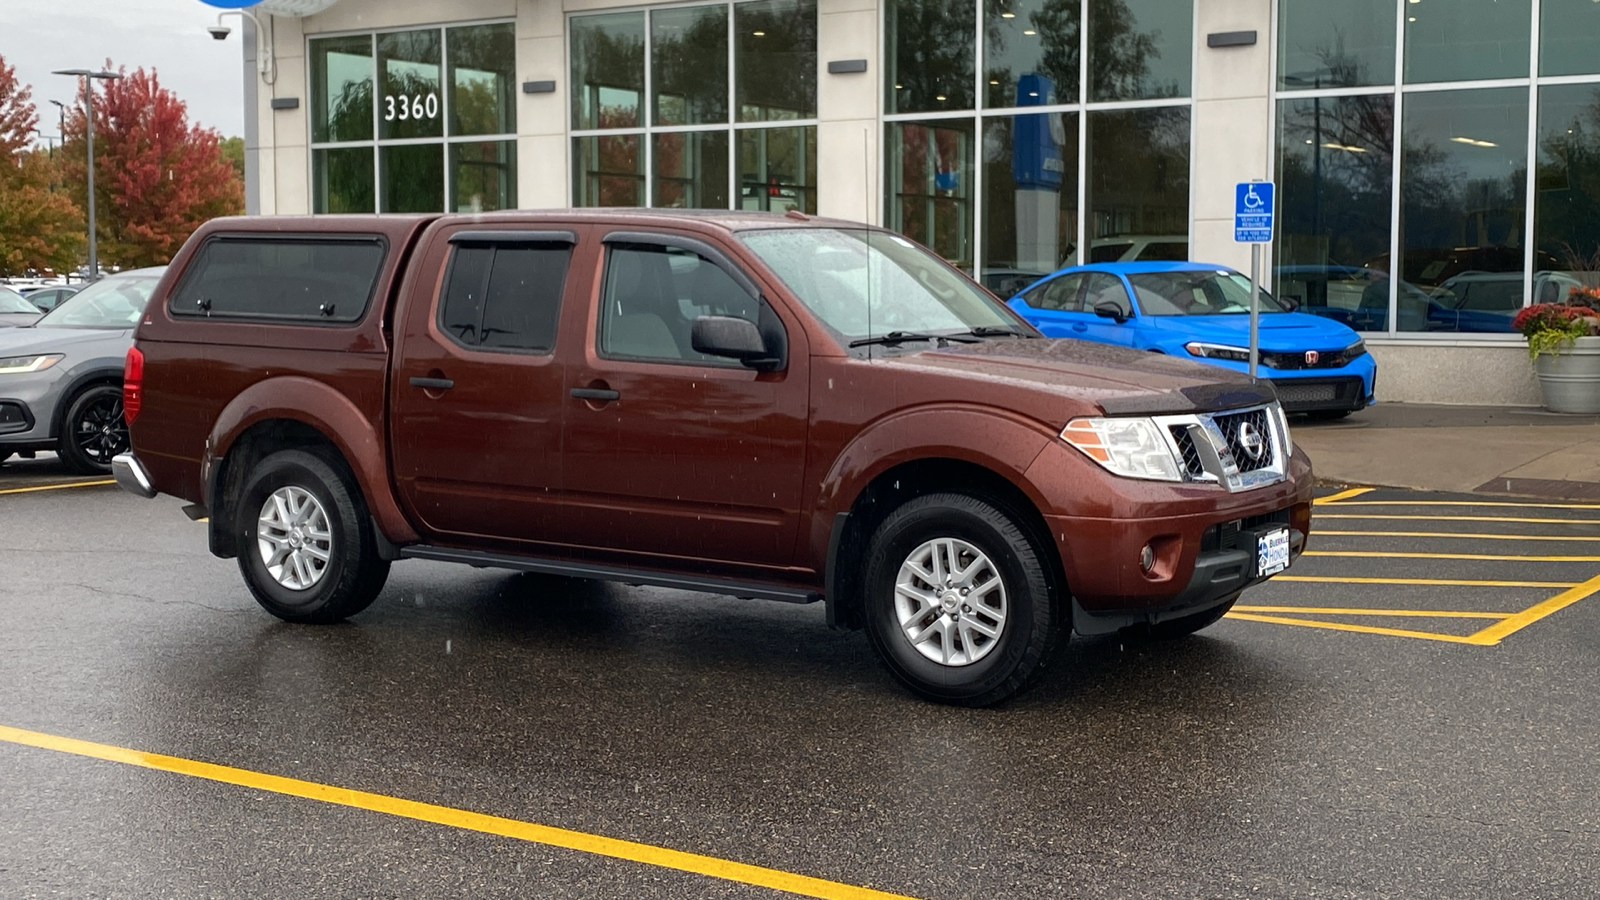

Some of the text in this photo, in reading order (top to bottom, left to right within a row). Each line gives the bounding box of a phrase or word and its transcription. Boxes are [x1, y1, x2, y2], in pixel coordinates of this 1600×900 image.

[385, 93, 438, 120] 3360
[1270, 536, 1289, 548] BUERKLE
[1269, 546, 1288, 563] HONDA
